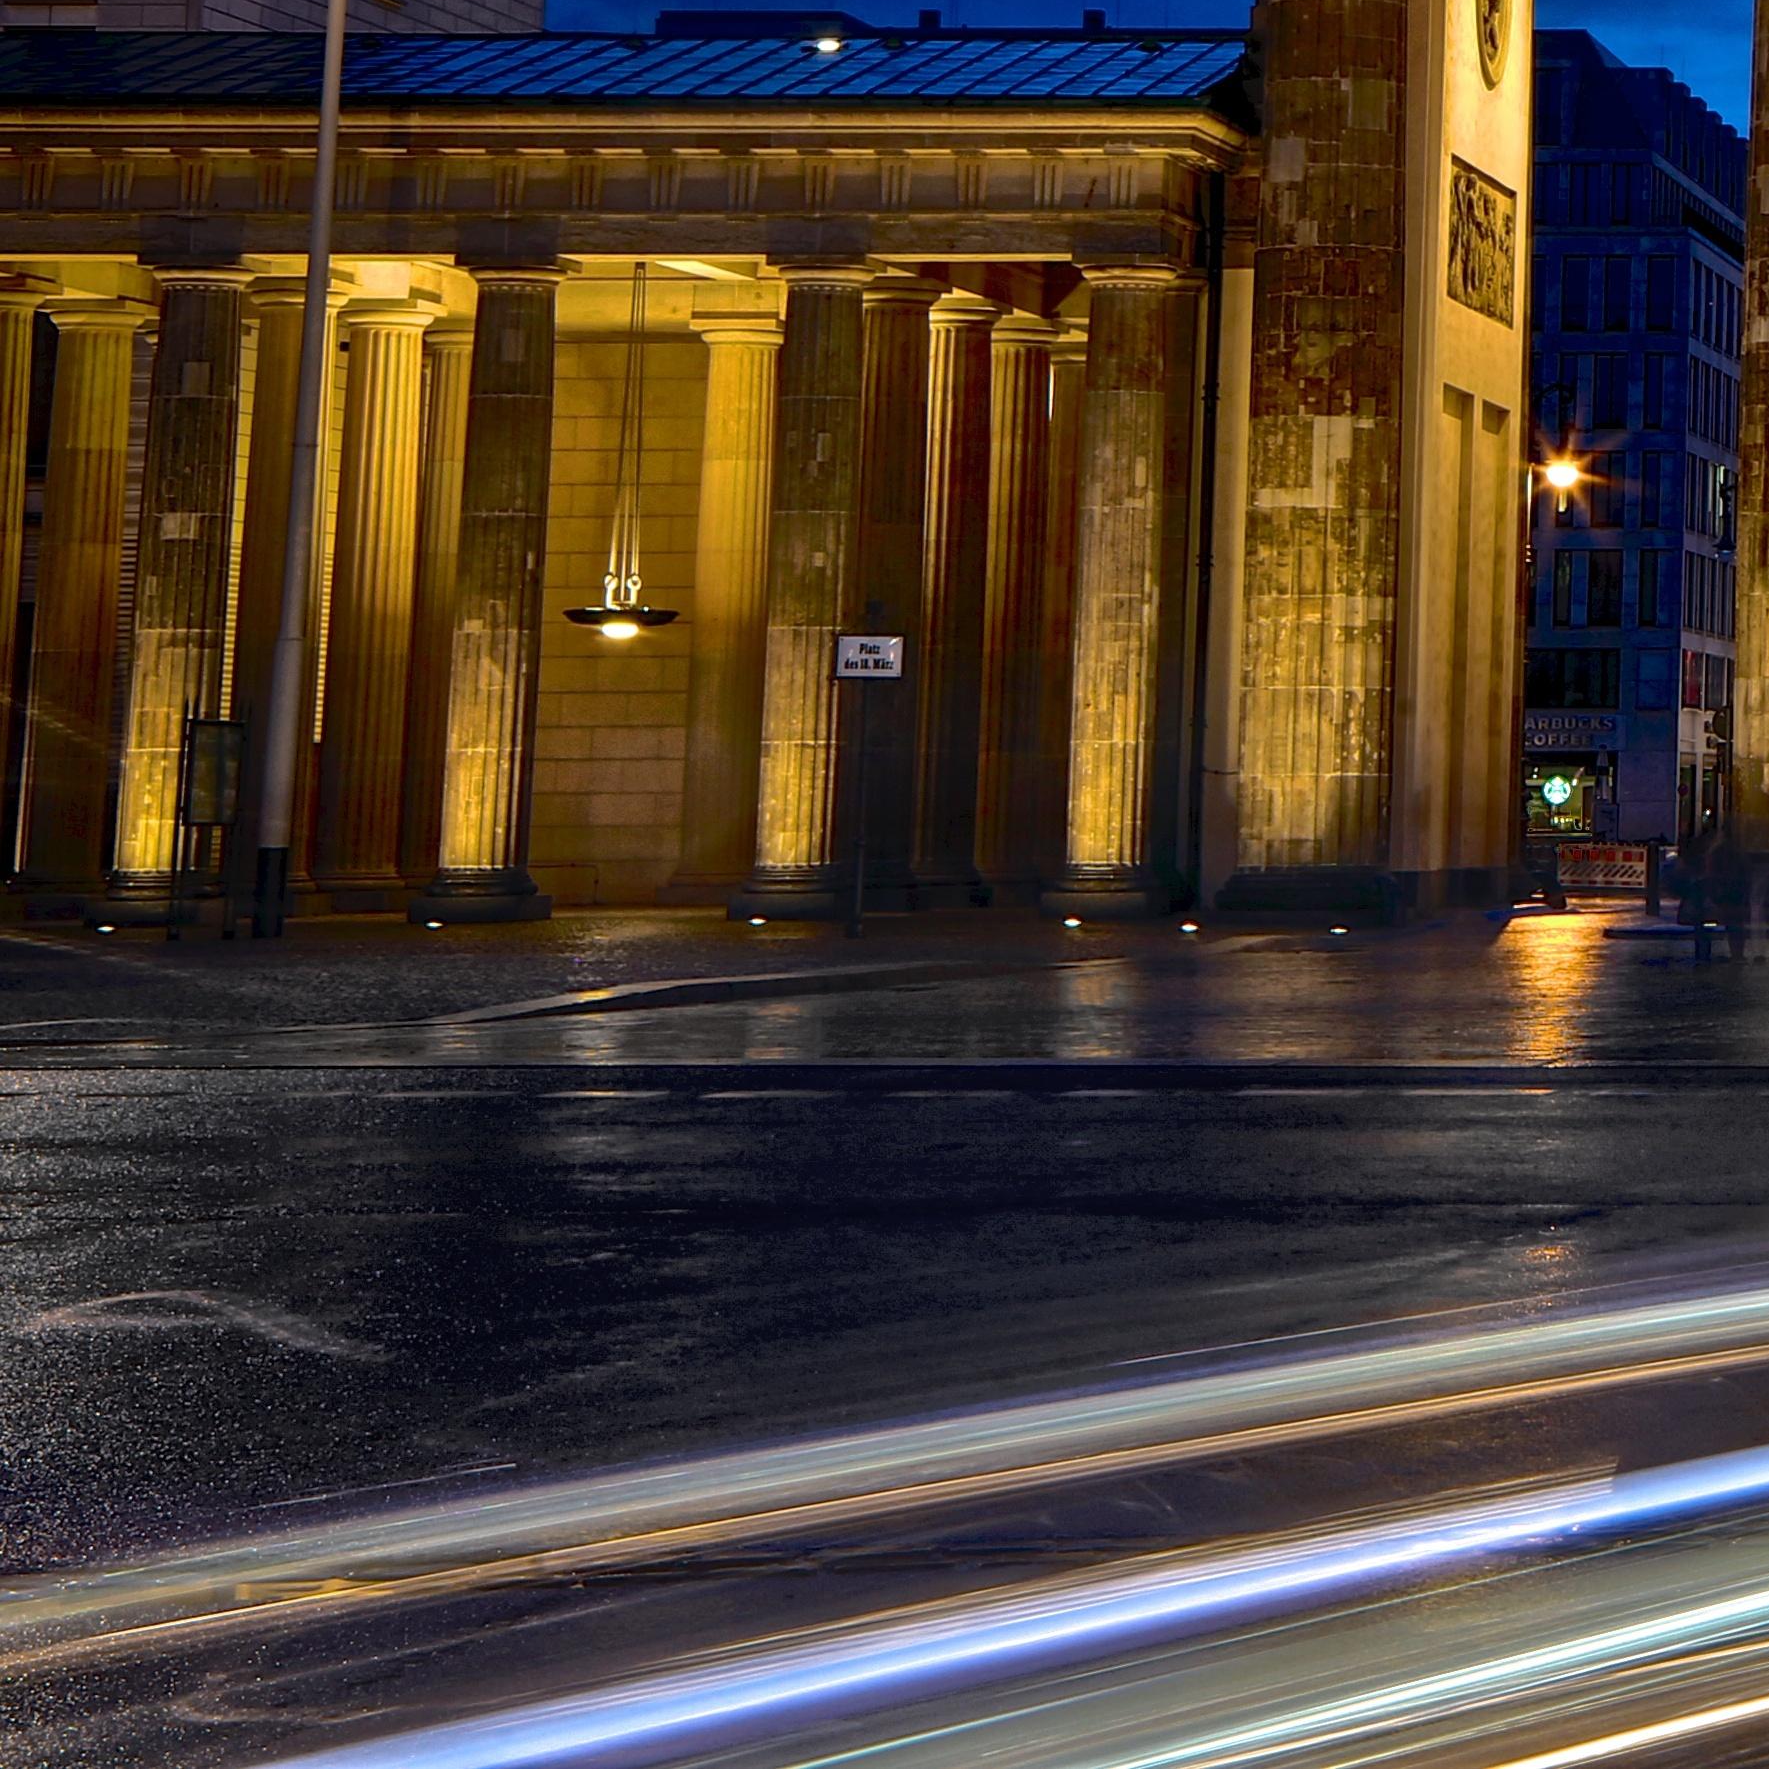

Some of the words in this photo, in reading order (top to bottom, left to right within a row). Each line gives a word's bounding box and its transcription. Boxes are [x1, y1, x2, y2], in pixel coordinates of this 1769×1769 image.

[859, 643, 881, 655] Platz
[844, 658, 858, 669] des
[872, 658, 894, 670] März
[1525, 717, 1613, 730] ARBUCKS
